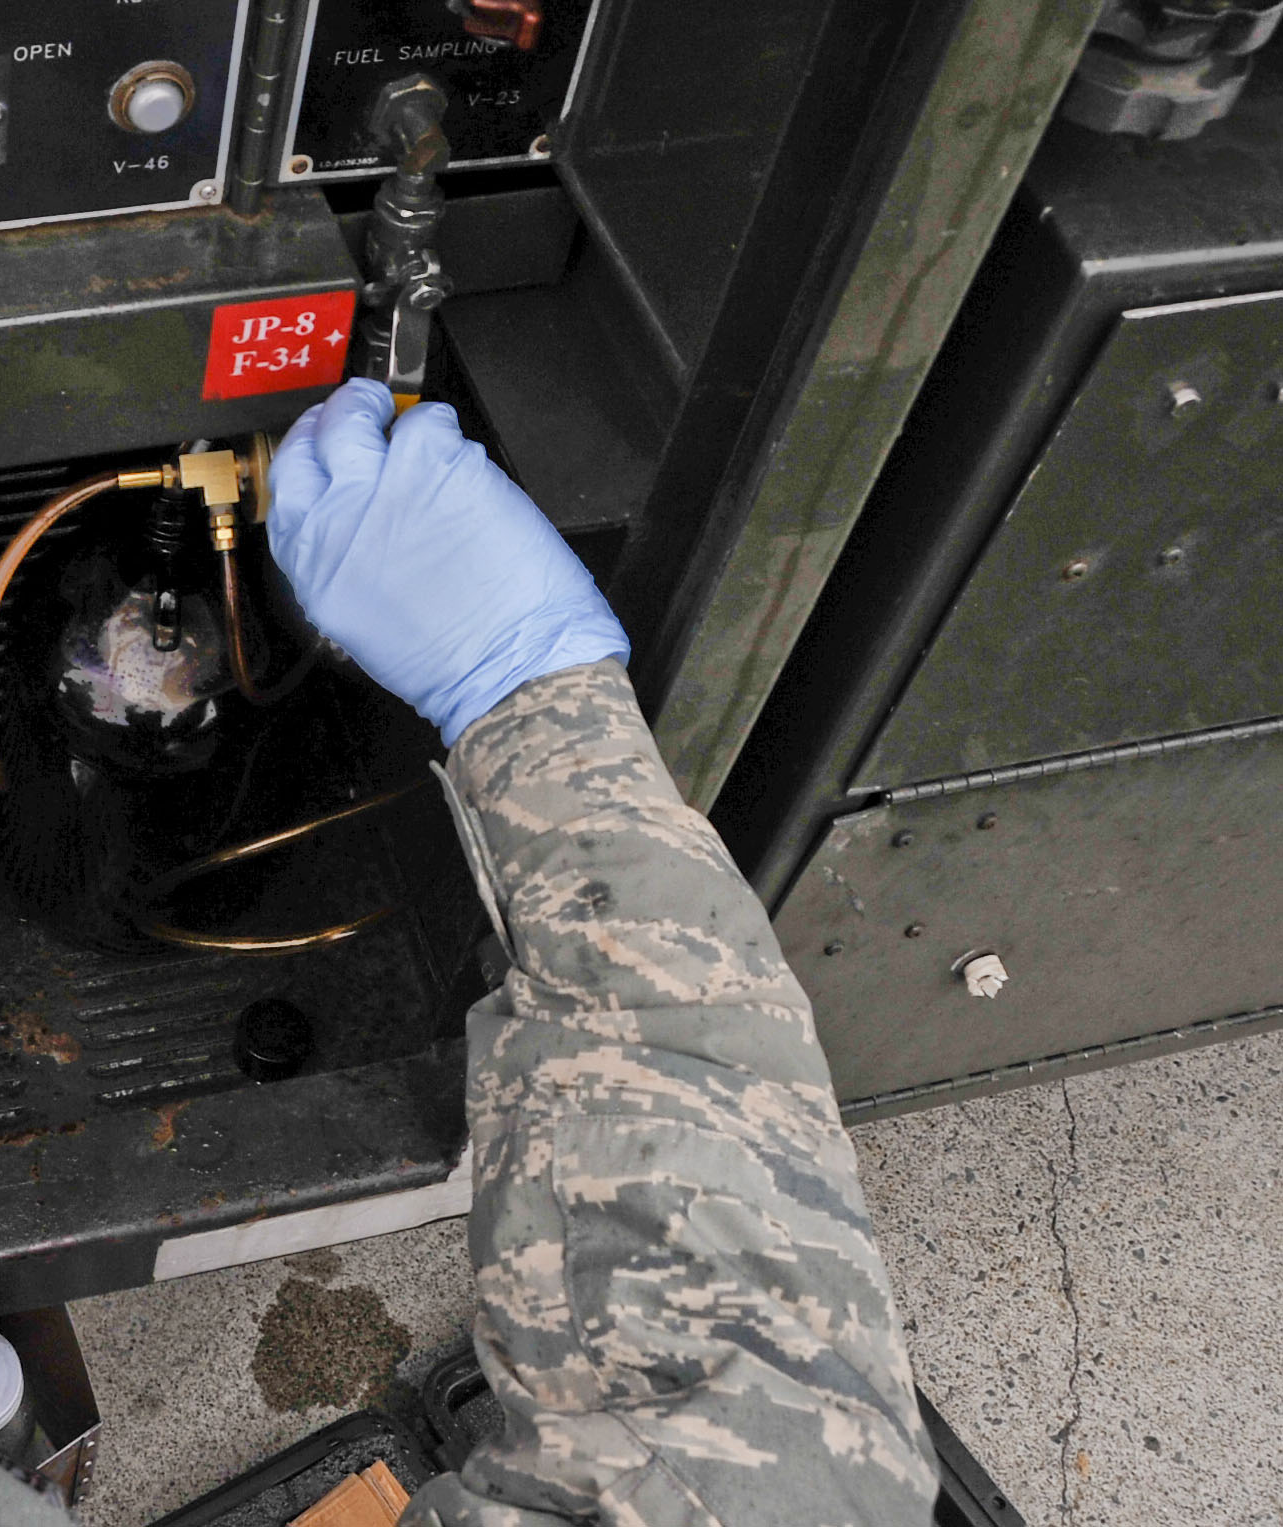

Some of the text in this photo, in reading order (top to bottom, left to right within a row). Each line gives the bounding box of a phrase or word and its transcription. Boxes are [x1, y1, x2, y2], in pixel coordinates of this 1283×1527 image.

[13, 42, 72, 62] OPEN
[334, 41, 498, 66] FUEL SAMPLING
[468, 90, 521, 106] V-23
[113, 155, 170, 174] V-46
[232, 311, 316, 345] JP-8
[230, 344, 311, 377] F-34
